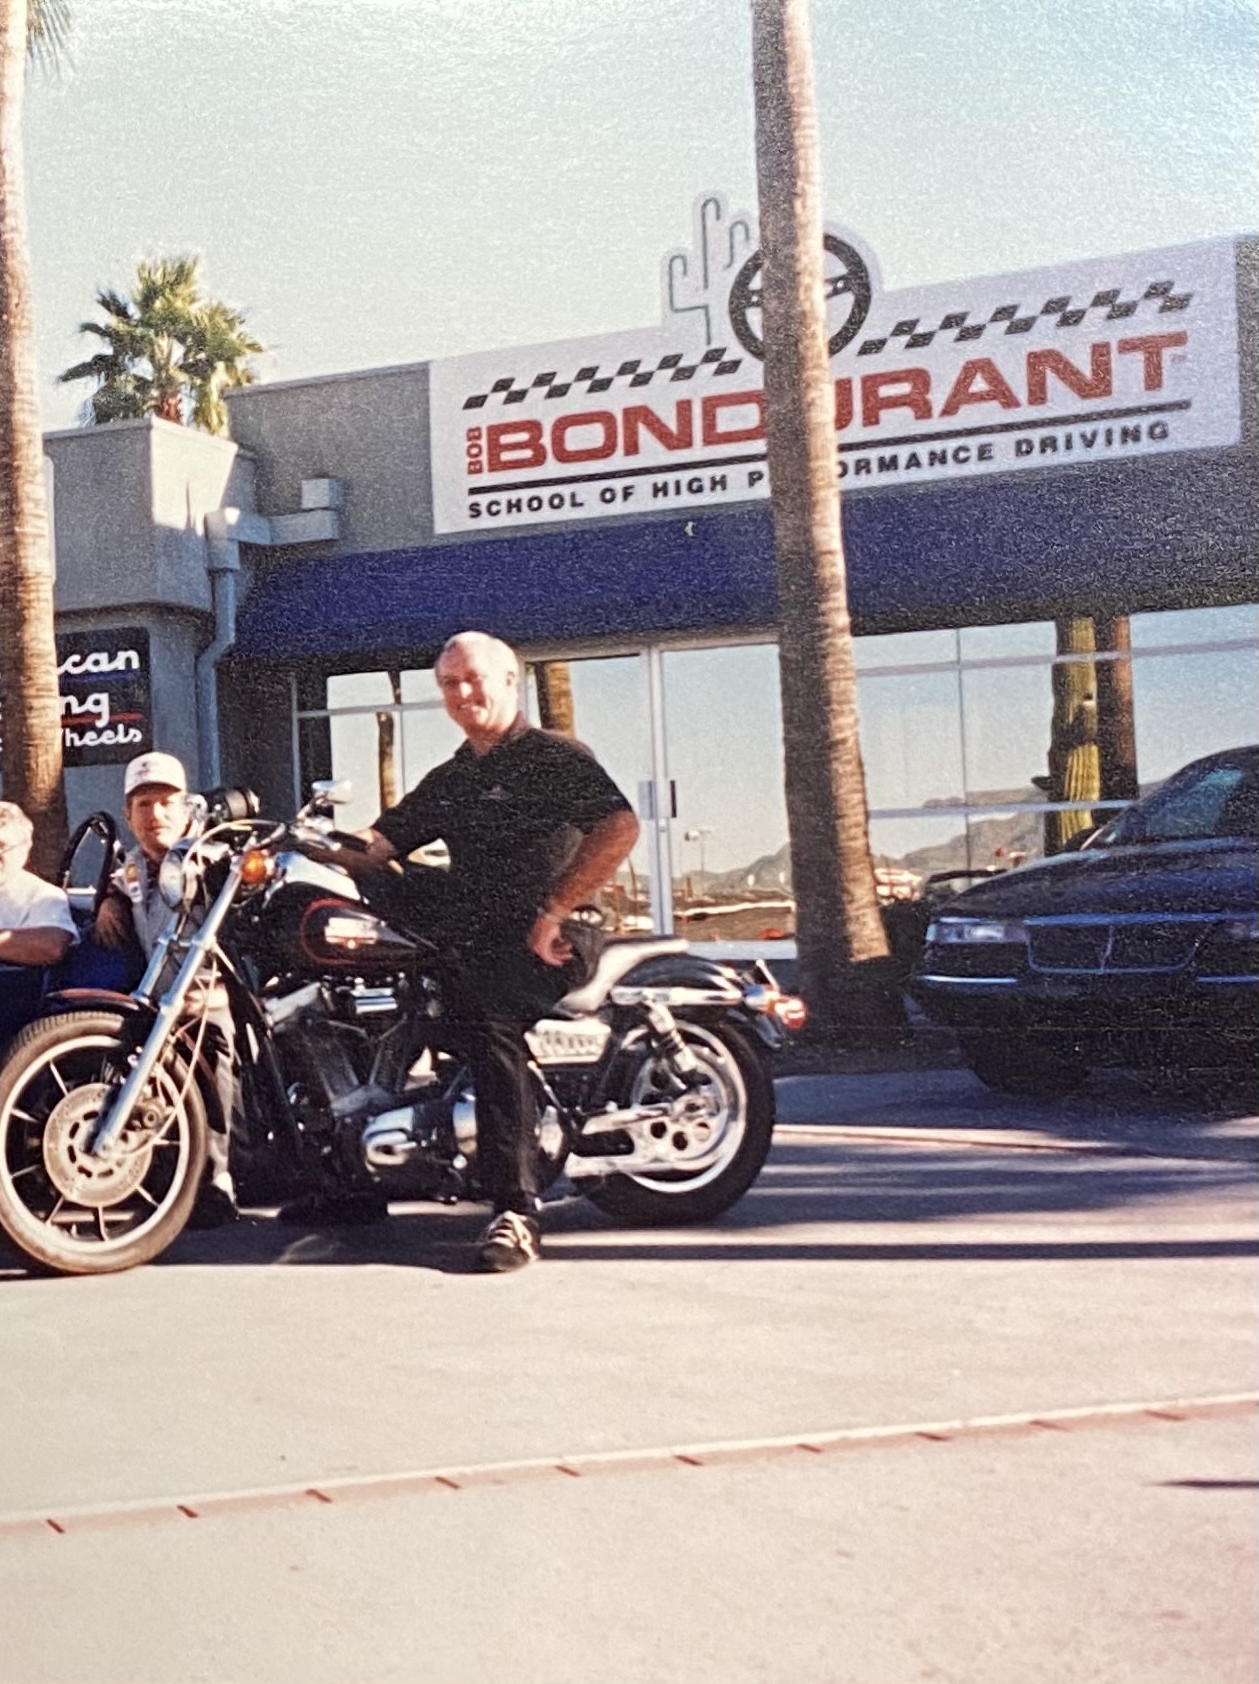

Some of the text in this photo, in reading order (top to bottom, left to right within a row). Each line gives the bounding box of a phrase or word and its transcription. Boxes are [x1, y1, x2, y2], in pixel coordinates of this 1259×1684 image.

[466, 331, 1189, 475] BOB BONDRANT
[468, 420, 1171, 519] SCHOOL OF HIGH PRMANCE DRIVING
[64, 723, 143, 747] heels
